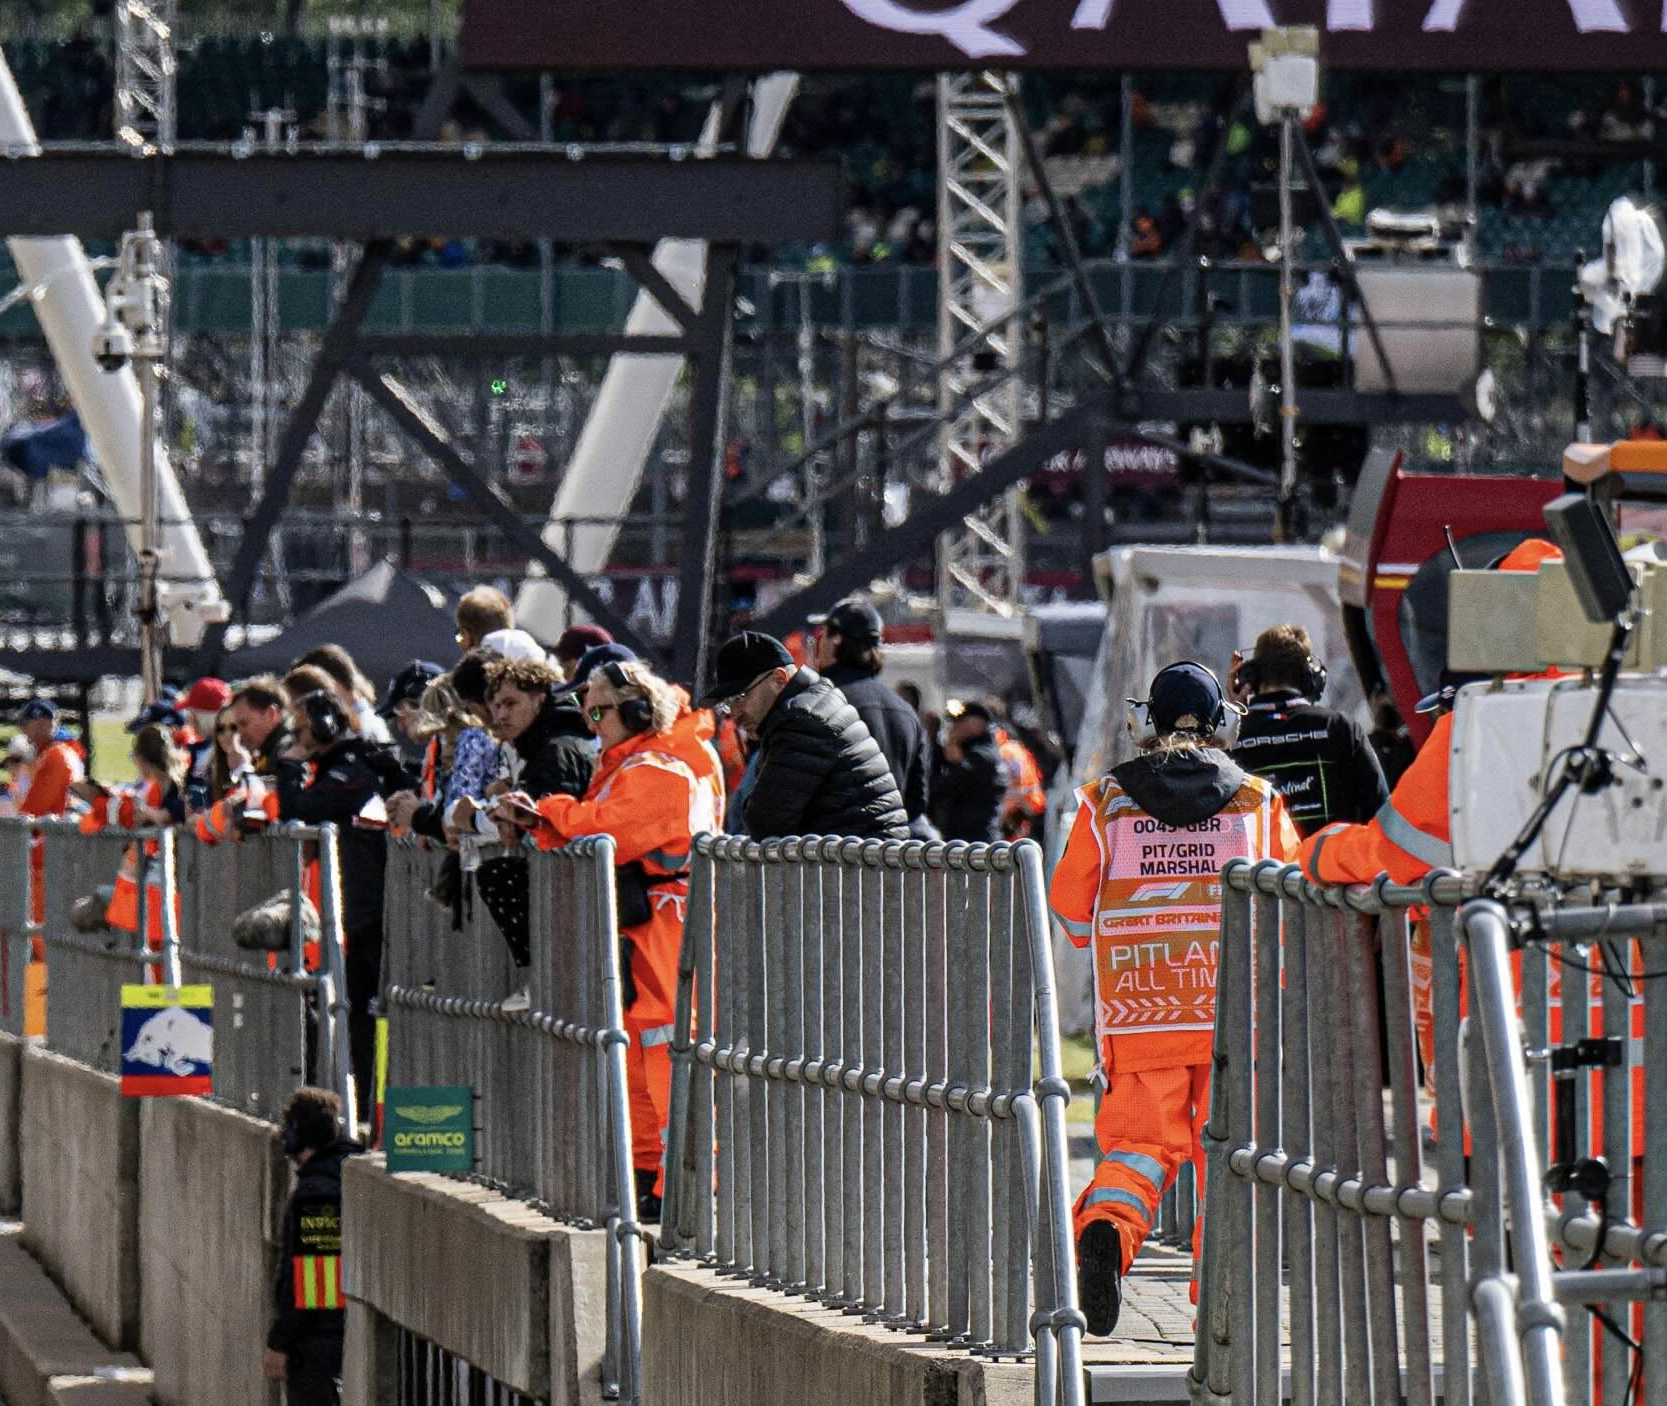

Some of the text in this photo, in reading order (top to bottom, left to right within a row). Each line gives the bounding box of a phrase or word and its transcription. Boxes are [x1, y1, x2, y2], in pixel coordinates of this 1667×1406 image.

[1142, 843, 1215, 859] PIT/GRID
[1140, 860, 1220, 876] MARSHAL
[1110, 940, 1219, 970] PITLAN
[1115, 966, 1216, 992] ALL TIM
[394, 1131, 466, 1147] aramco
